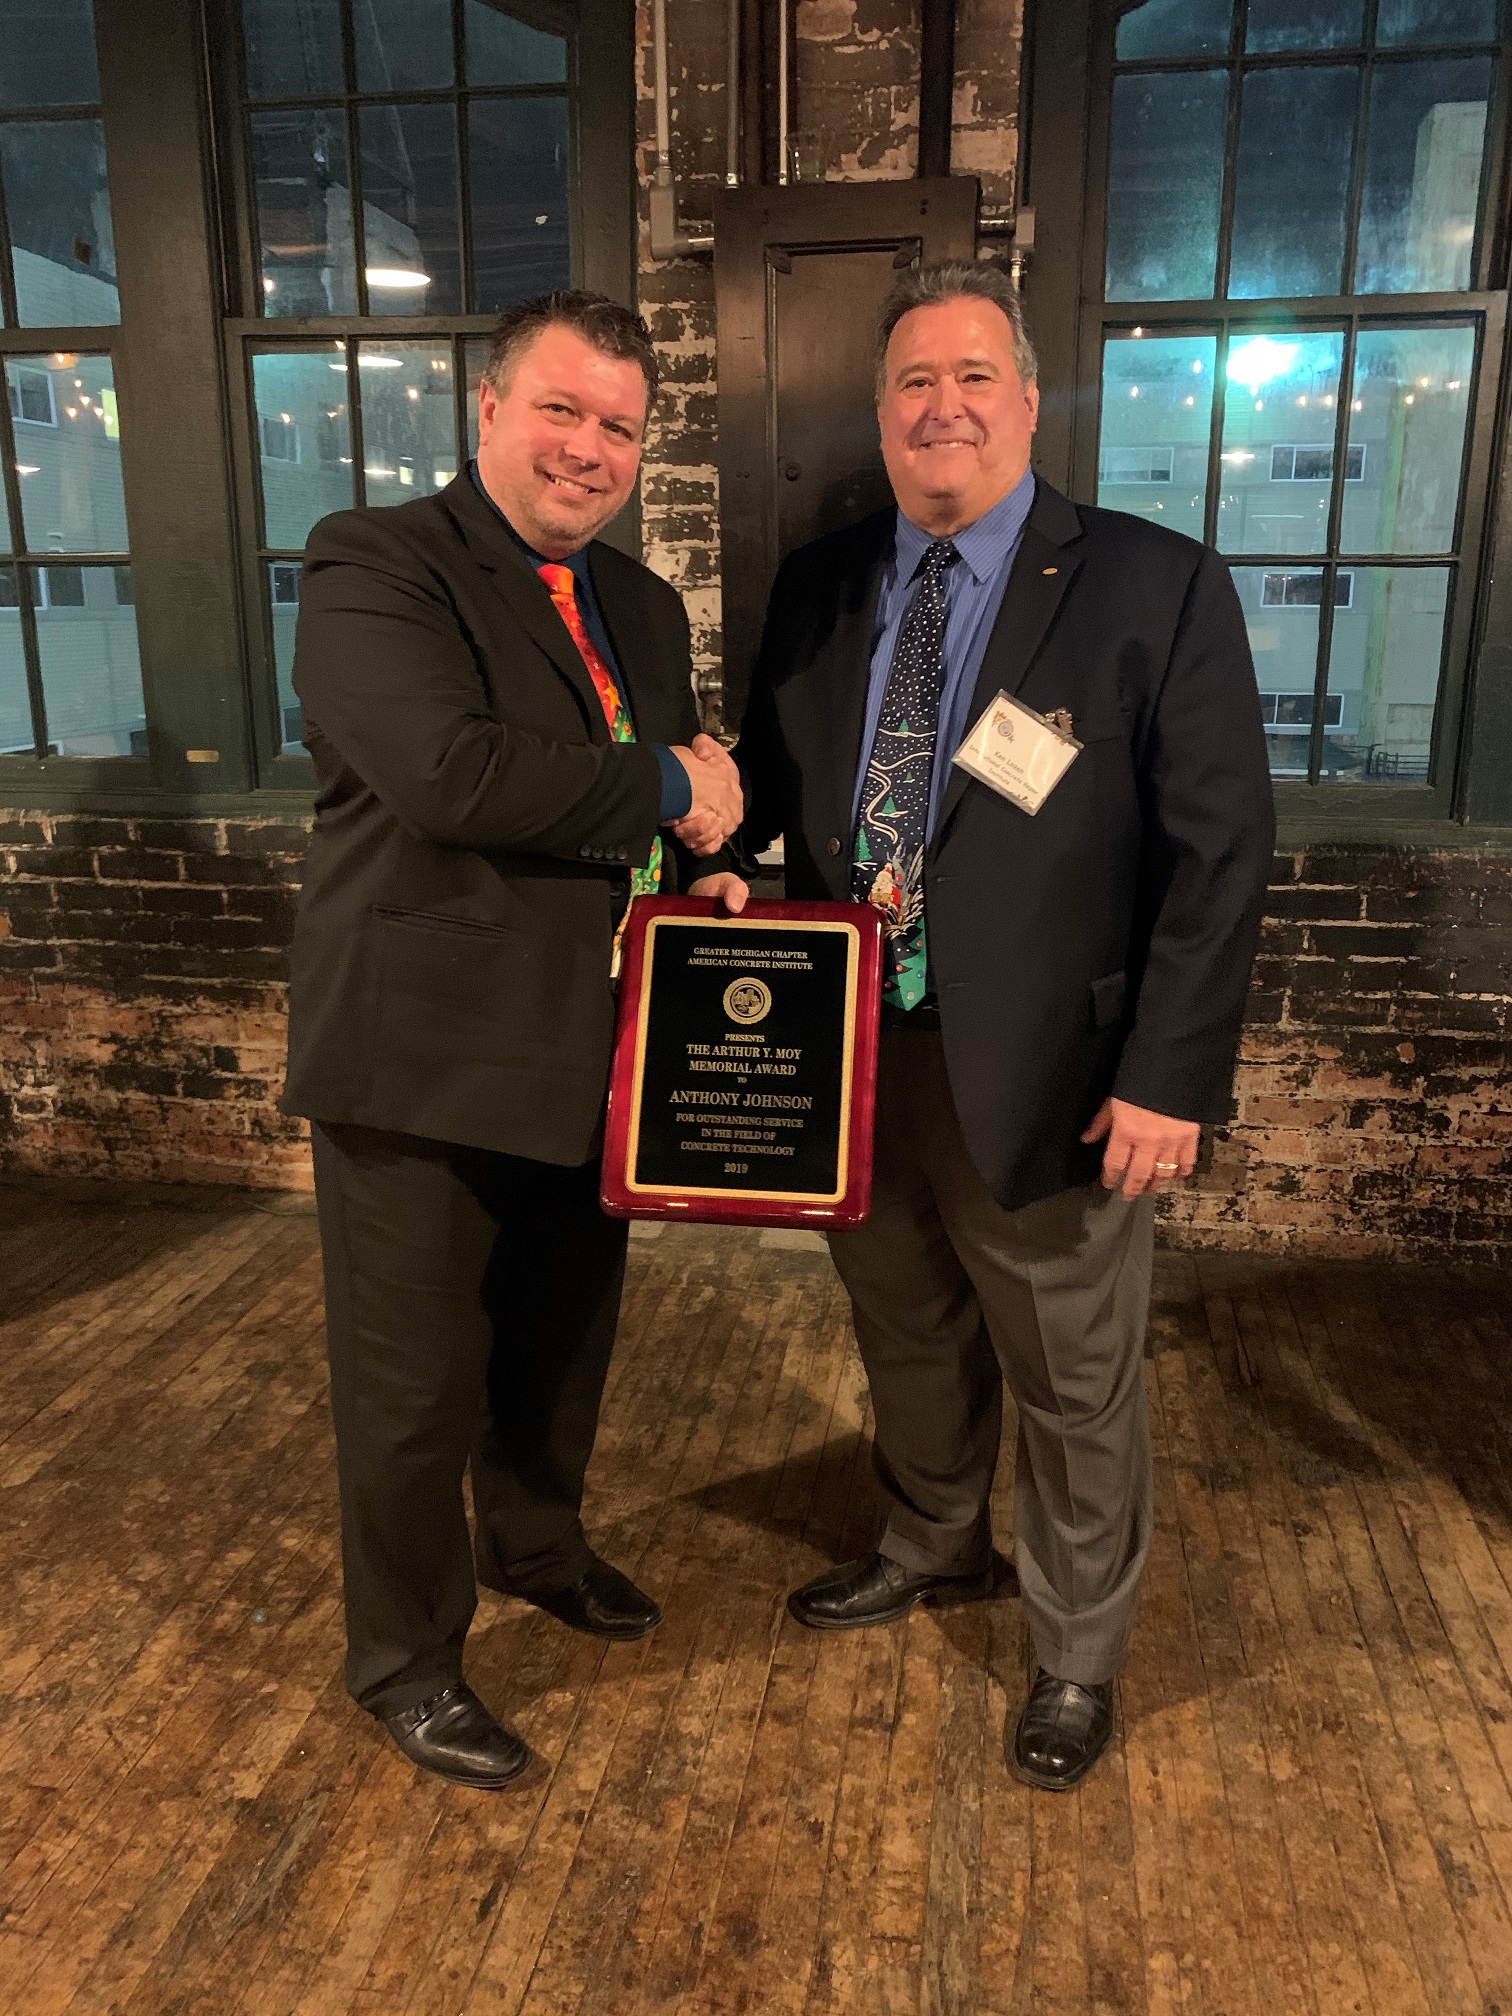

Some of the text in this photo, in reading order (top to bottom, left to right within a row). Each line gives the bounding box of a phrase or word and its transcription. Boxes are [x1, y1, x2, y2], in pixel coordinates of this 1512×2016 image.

[994, 751, 1006, 761] Ken
[694, 947, 808, 959] GREATER MICHIGAN CHAPTER
[687, 958, 813, 970] AMERICAN CONCRETE INSTITUTE
[725, 1034, 765, 1042] PRESENTS
[686, 1044, 802, 1060] THE ARTHUR Y. MOY
[689, 1060, 796, 1075] MEMORIAL AWARD
[669, 1090, 813, 1110] ANTHONY JOHNSON
[676, 1112, 803, 1128] FOR OUTSTANDING SERVICE
[701, 1128, 776, 1140] IN THE FIELD OF
[680, 1141, 795, 1156] CONCRETE TECHNOLOGY
[724, 1162, 748, 1174] 2019
